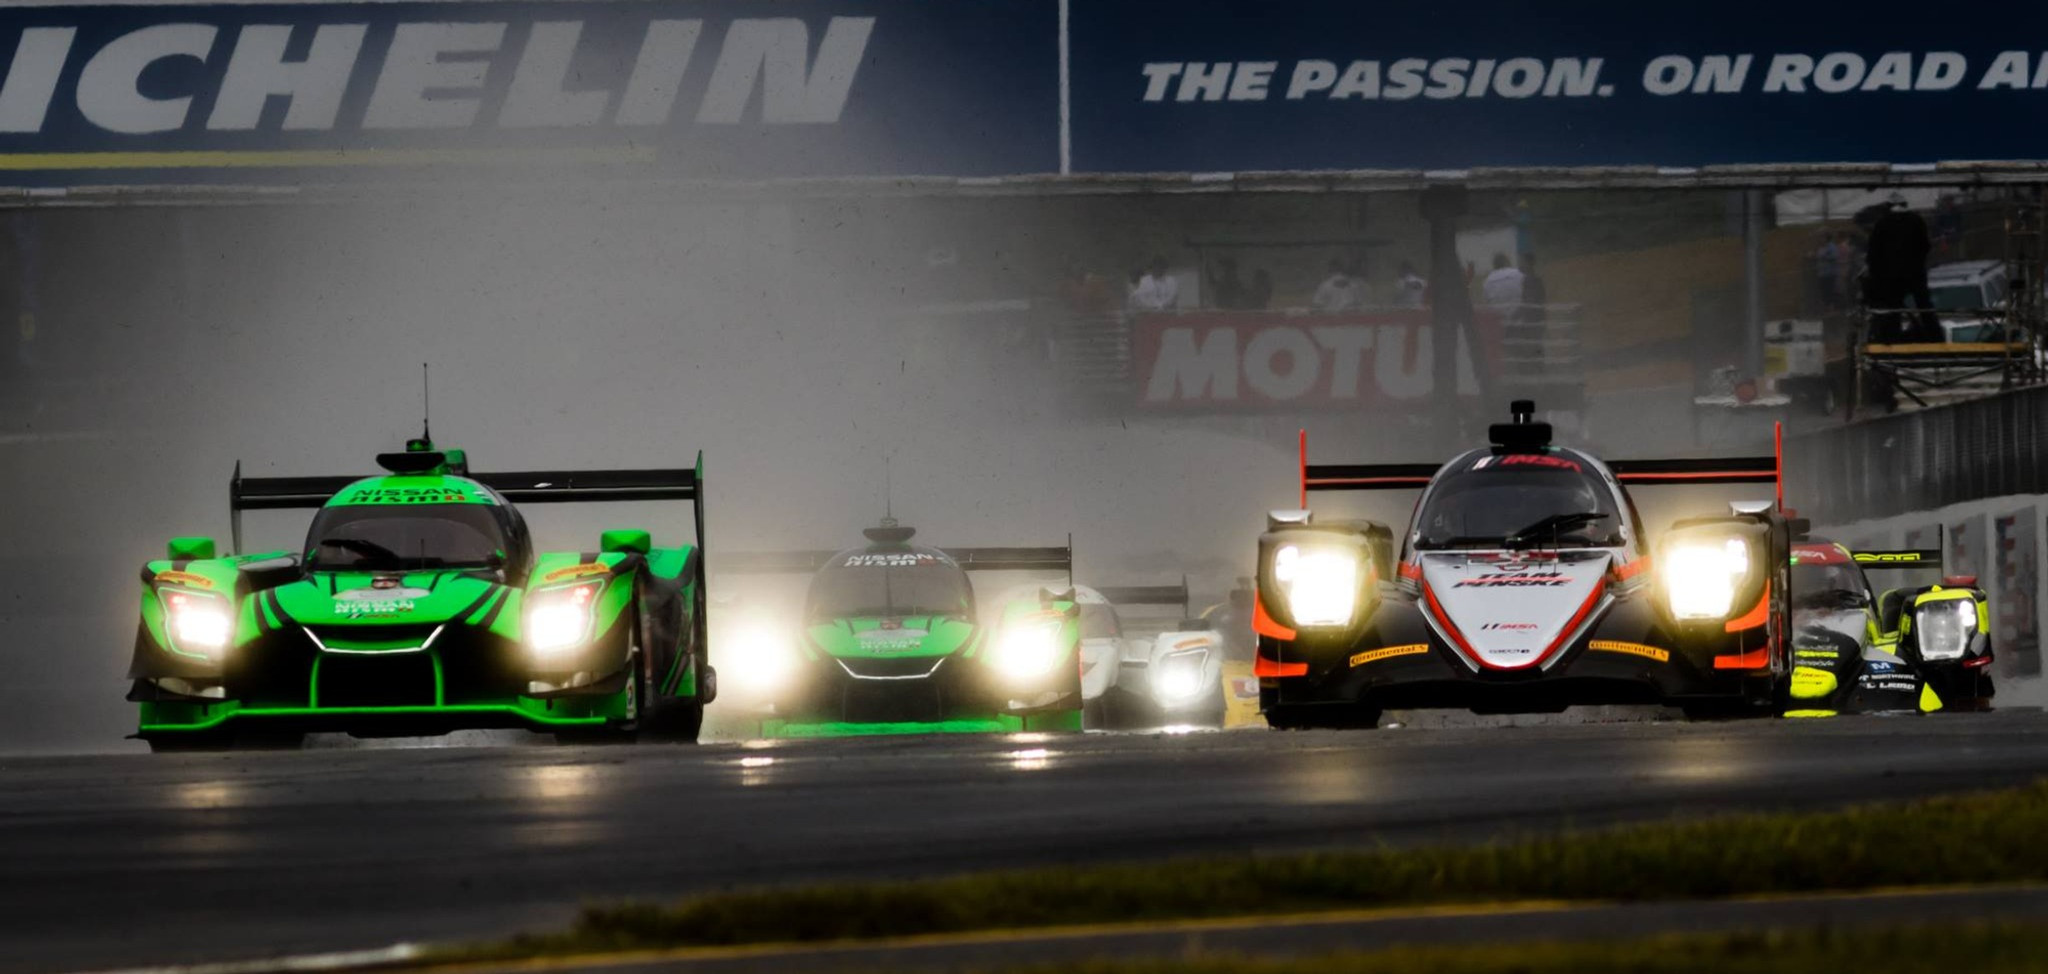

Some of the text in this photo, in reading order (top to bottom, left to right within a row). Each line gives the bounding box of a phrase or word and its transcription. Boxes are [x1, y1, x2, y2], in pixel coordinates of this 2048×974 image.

[1142, 61, 1277, 100] THE
[1287, 57, 1616, 99] PASSION.
[1643, 54, 1753, 96] ON
[1763, 52, 1967, 93] ROAD
[354, 488, 464, 496] NISSAN
[1350, 645, 1416, 665] Continental
